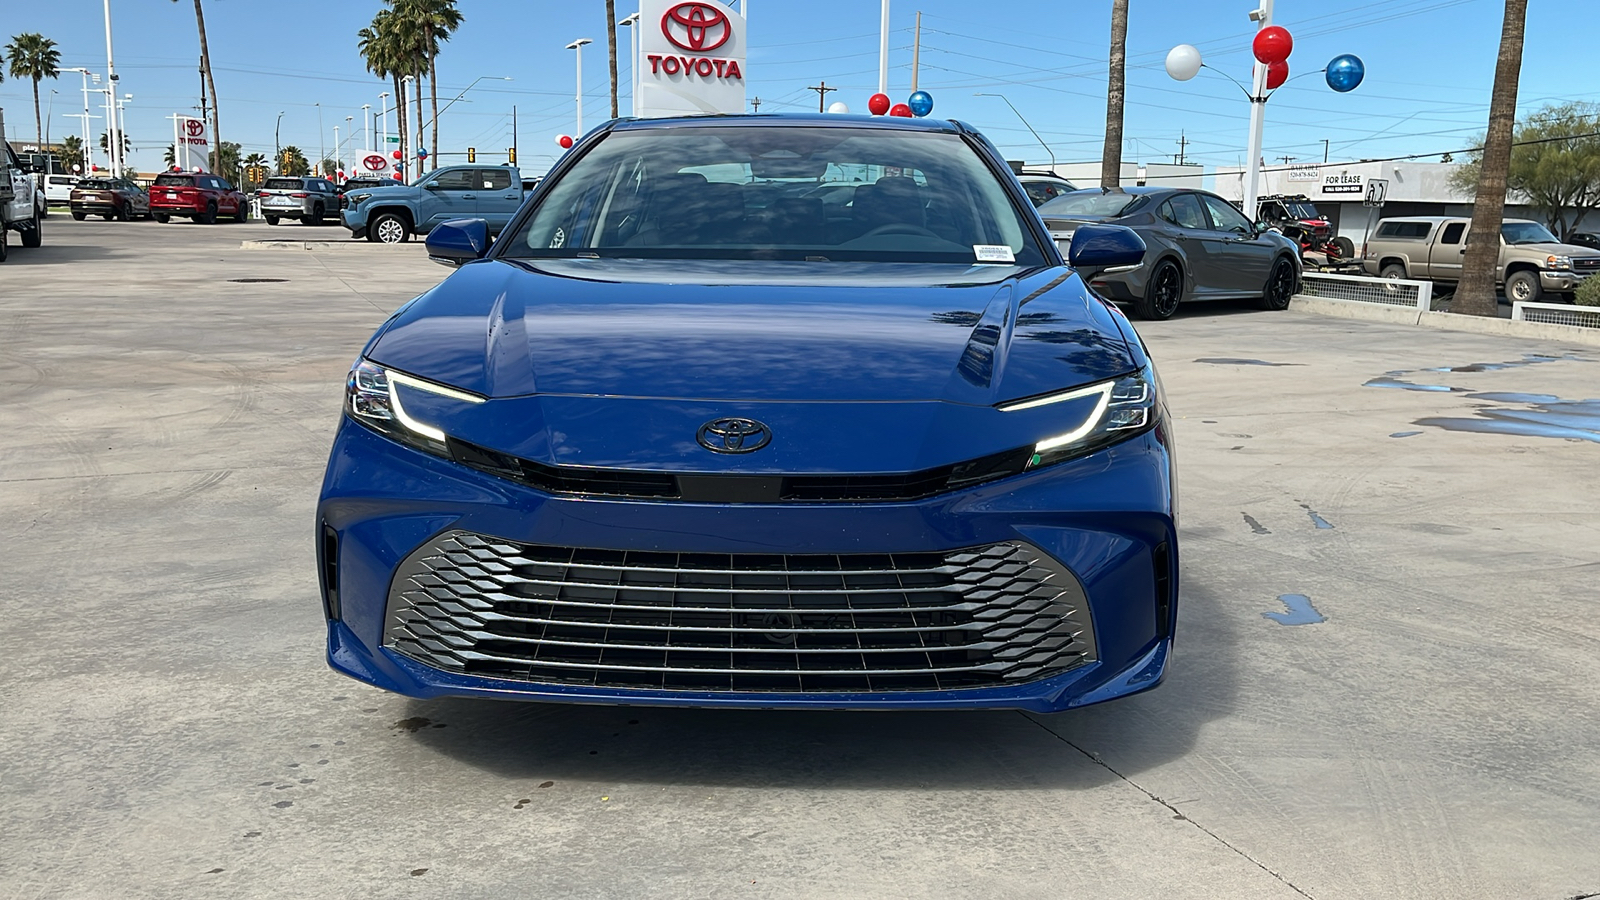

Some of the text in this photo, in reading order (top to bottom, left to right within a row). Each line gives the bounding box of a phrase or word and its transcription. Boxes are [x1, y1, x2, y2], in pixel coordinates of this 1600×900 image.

[647, 55, 742, 79] TOYOTA
[1325, 176, 1339, 184] FOR
[1341, 175, 1361, 184] LEASE
